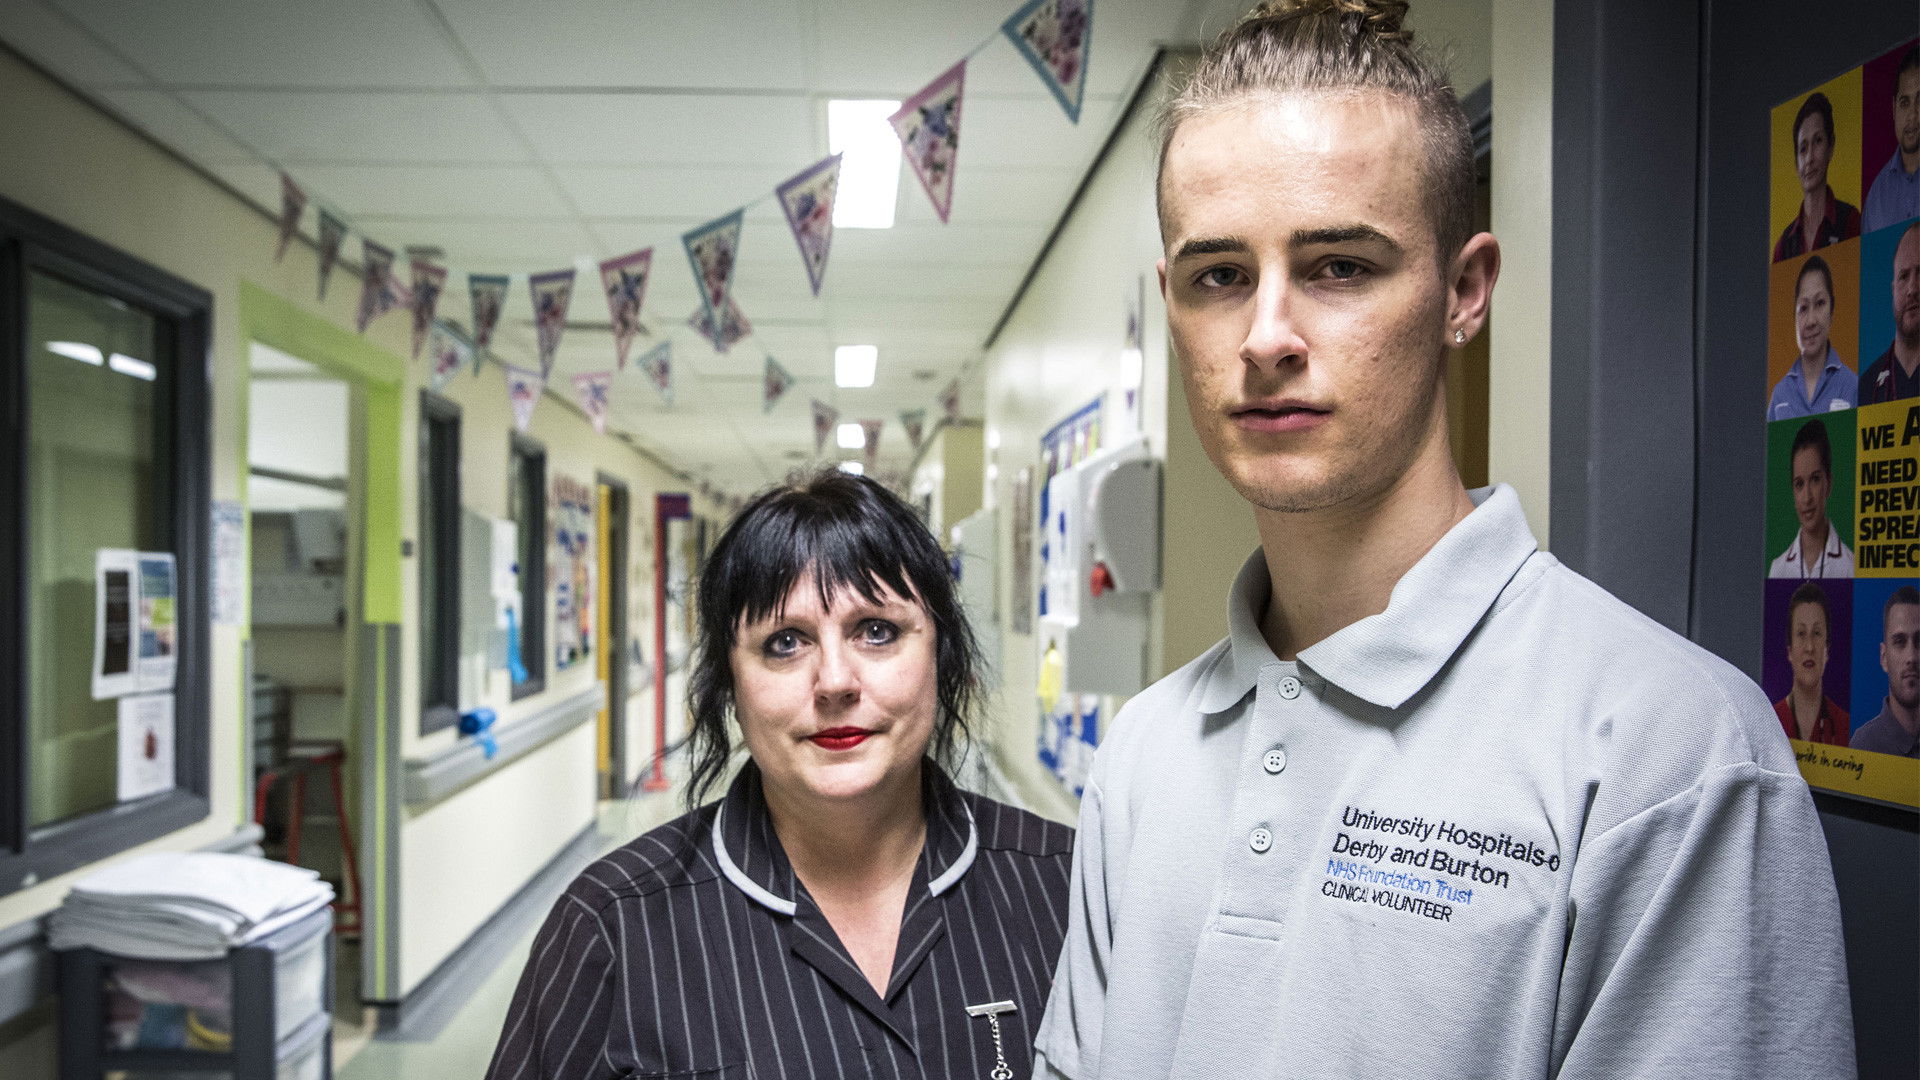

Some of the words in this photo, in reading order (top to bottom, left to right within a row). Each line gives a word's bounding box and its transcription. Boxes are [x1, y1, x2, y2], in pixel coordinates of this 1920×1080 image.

[1861, 424, 1896, 451] WE
[1860, 457, 1917, 486] NEED
[1860, 485, 1920, 514] PREV
[1820, 750, 1830, 767] in
[1832, 755, 1864, 781] caring
[1342, 805, 1435, 843] University
[1437, 821, 1545, 867] Hospitals
[1333, 833, 1388, 864] Derby
[1390, 847, 1430, 868] and
[1430, 849, 1510, 889] Burton
[1326, 858, 1357, 881] NHS
[1358, 864, 1431, 895] Foundation
[1435, 879, 1473, 905] Trust
[1371, 889, 1453, 923] VOLUNTEER
